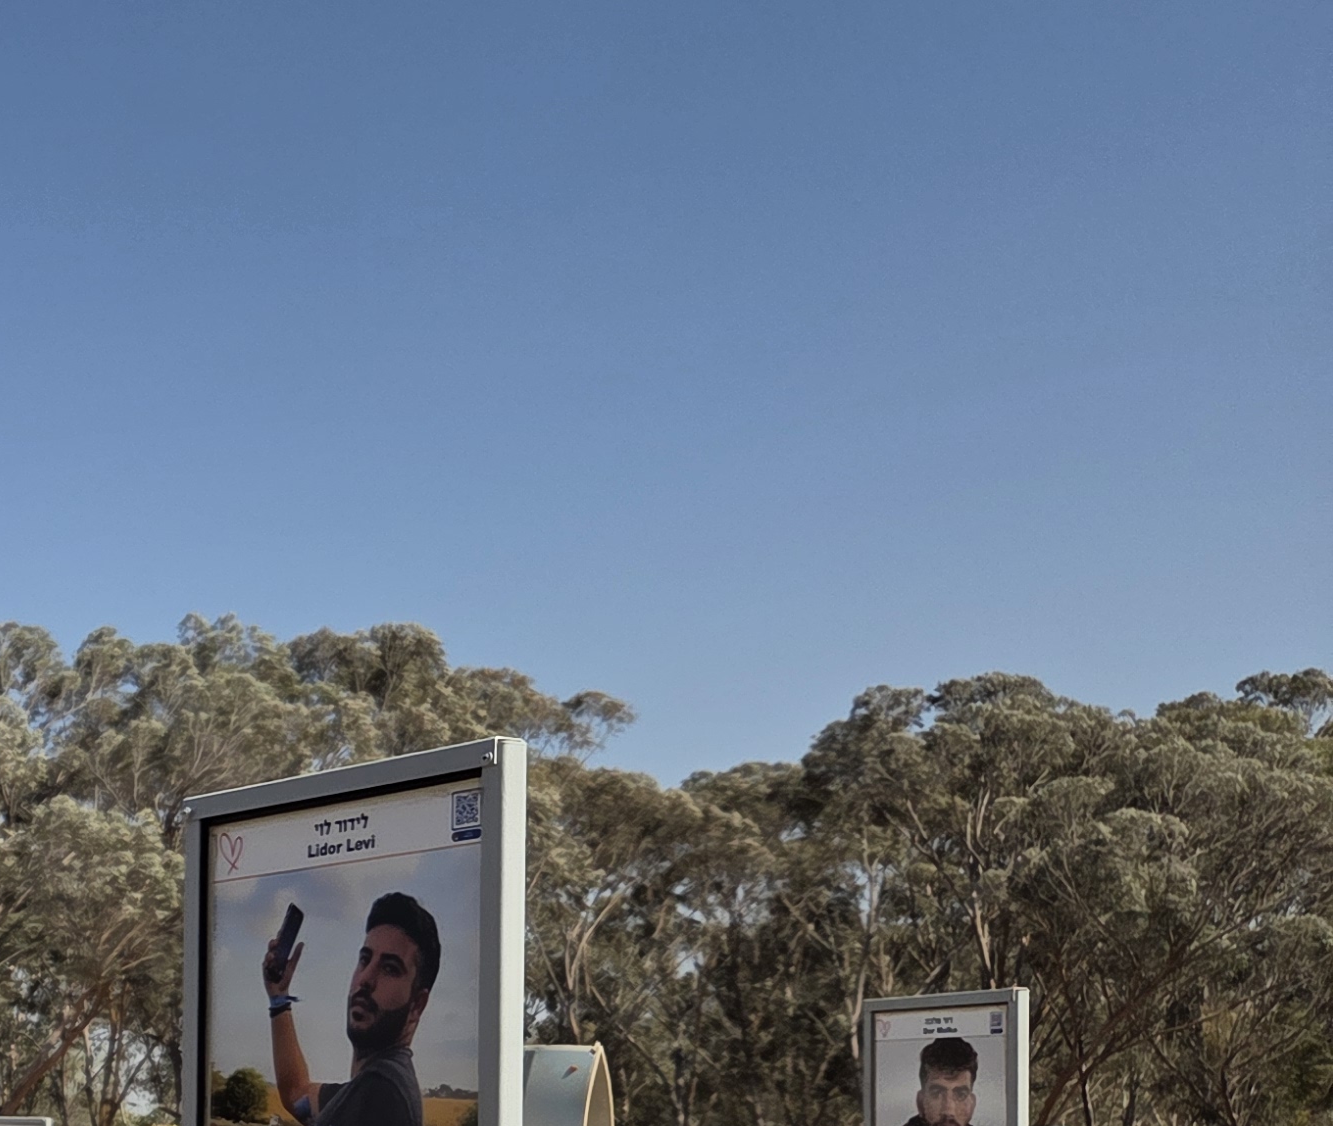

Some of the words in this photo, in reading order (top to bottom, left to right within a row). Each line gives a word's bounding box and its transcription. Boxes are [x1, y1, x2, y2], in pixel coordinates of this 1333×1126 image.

[314, 819, 331, 836] לוי
[335, 813, 369, 833] לידור
[308, 842, 343, 858] Lidor
[346, 834, 376, 853] Levi
